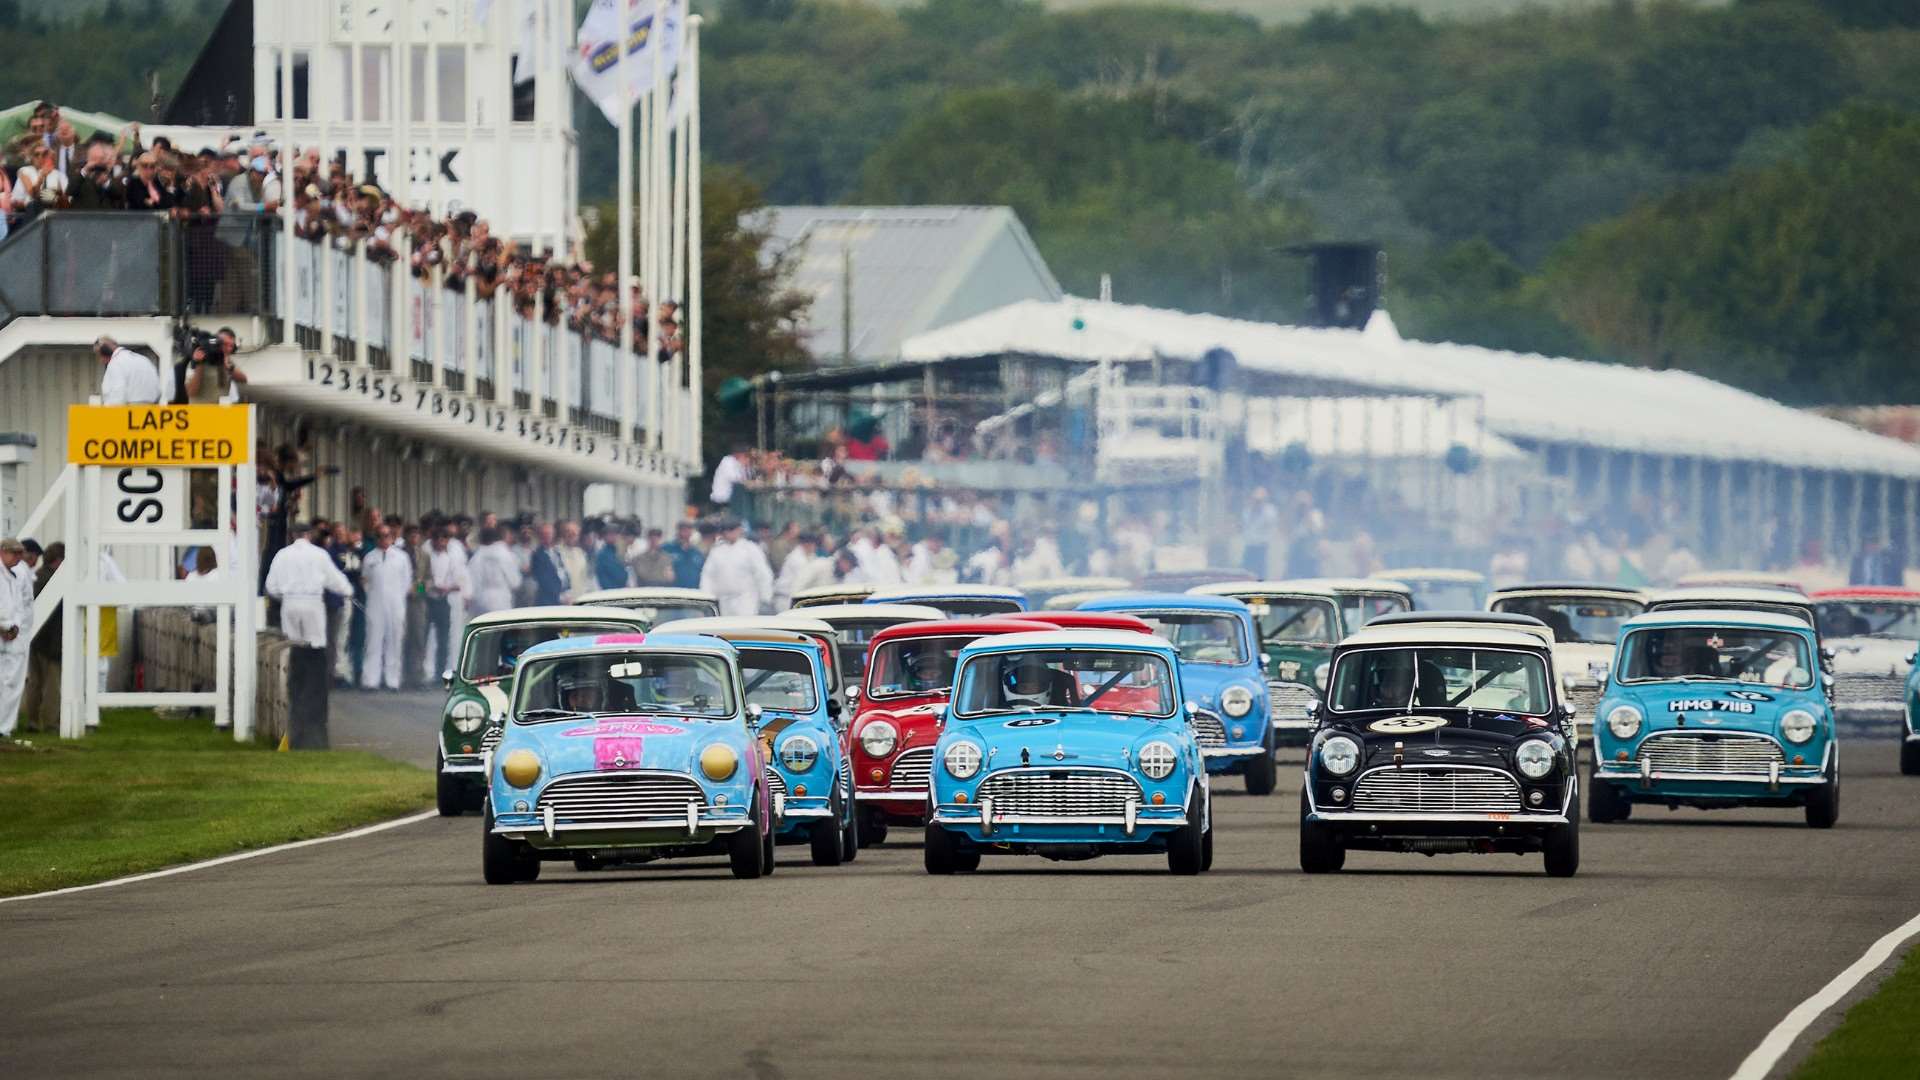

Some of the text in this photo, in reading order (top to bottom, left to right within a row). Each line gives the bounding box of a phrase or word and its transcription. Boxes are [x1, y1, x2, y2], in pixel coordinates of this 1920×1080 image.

[127, 409, 190, 431] LAPS
[83, 439, 233, 460] COMPLETED
[117, 468, 163, 523] SC
[1669, 699, 1753, 714] HMG 711B
